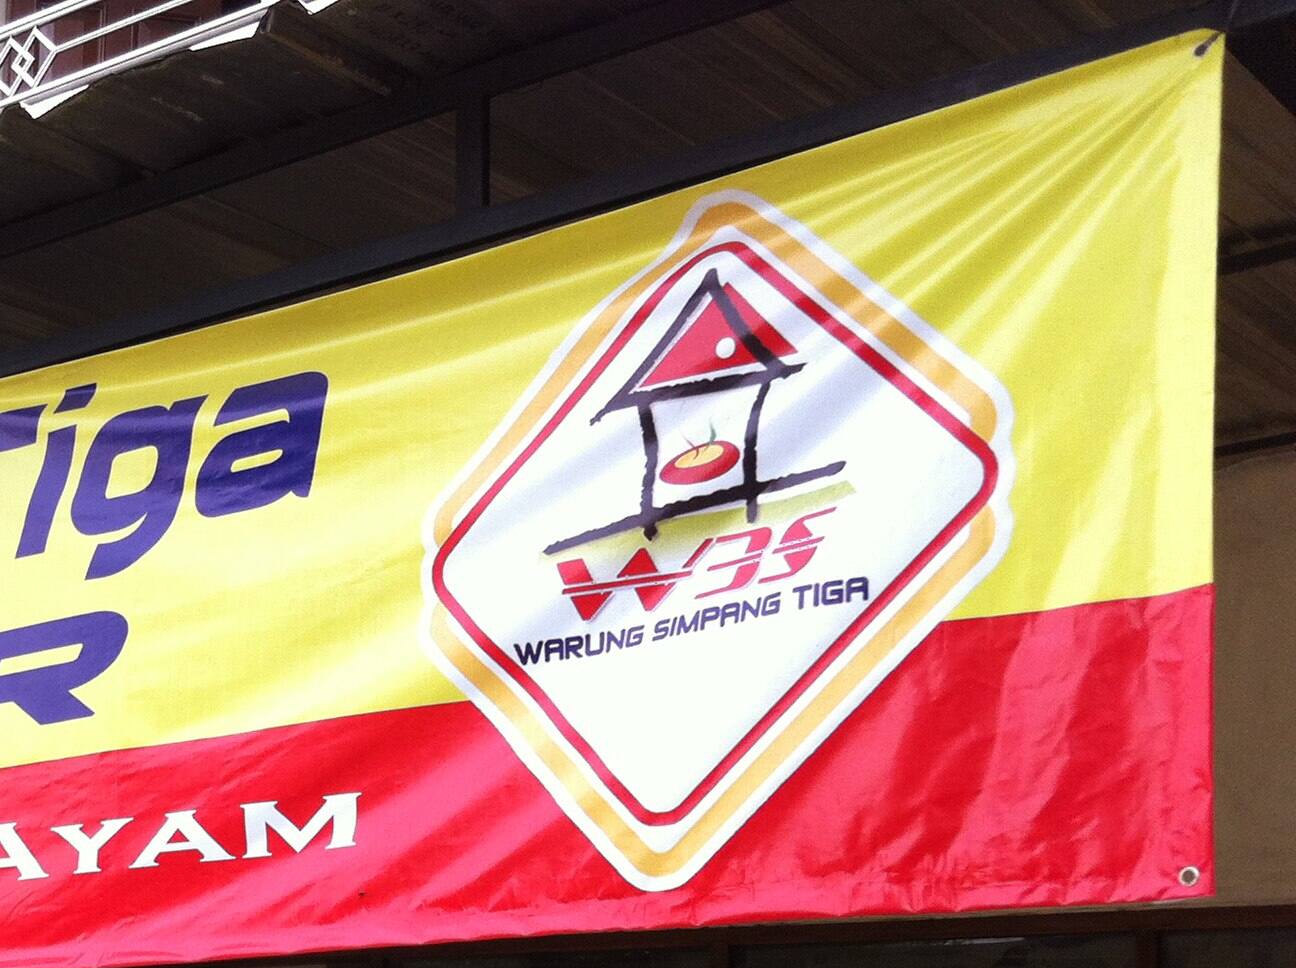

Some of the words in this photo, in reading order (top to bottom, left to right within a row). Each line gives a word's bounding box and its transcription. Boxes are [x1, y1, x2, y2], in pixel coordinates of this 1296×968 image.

[513, 625, 645, 665] WARUNG
[652, 591, 782, 642] SIMPANG
[793, 576, 870, 610] TIGA
